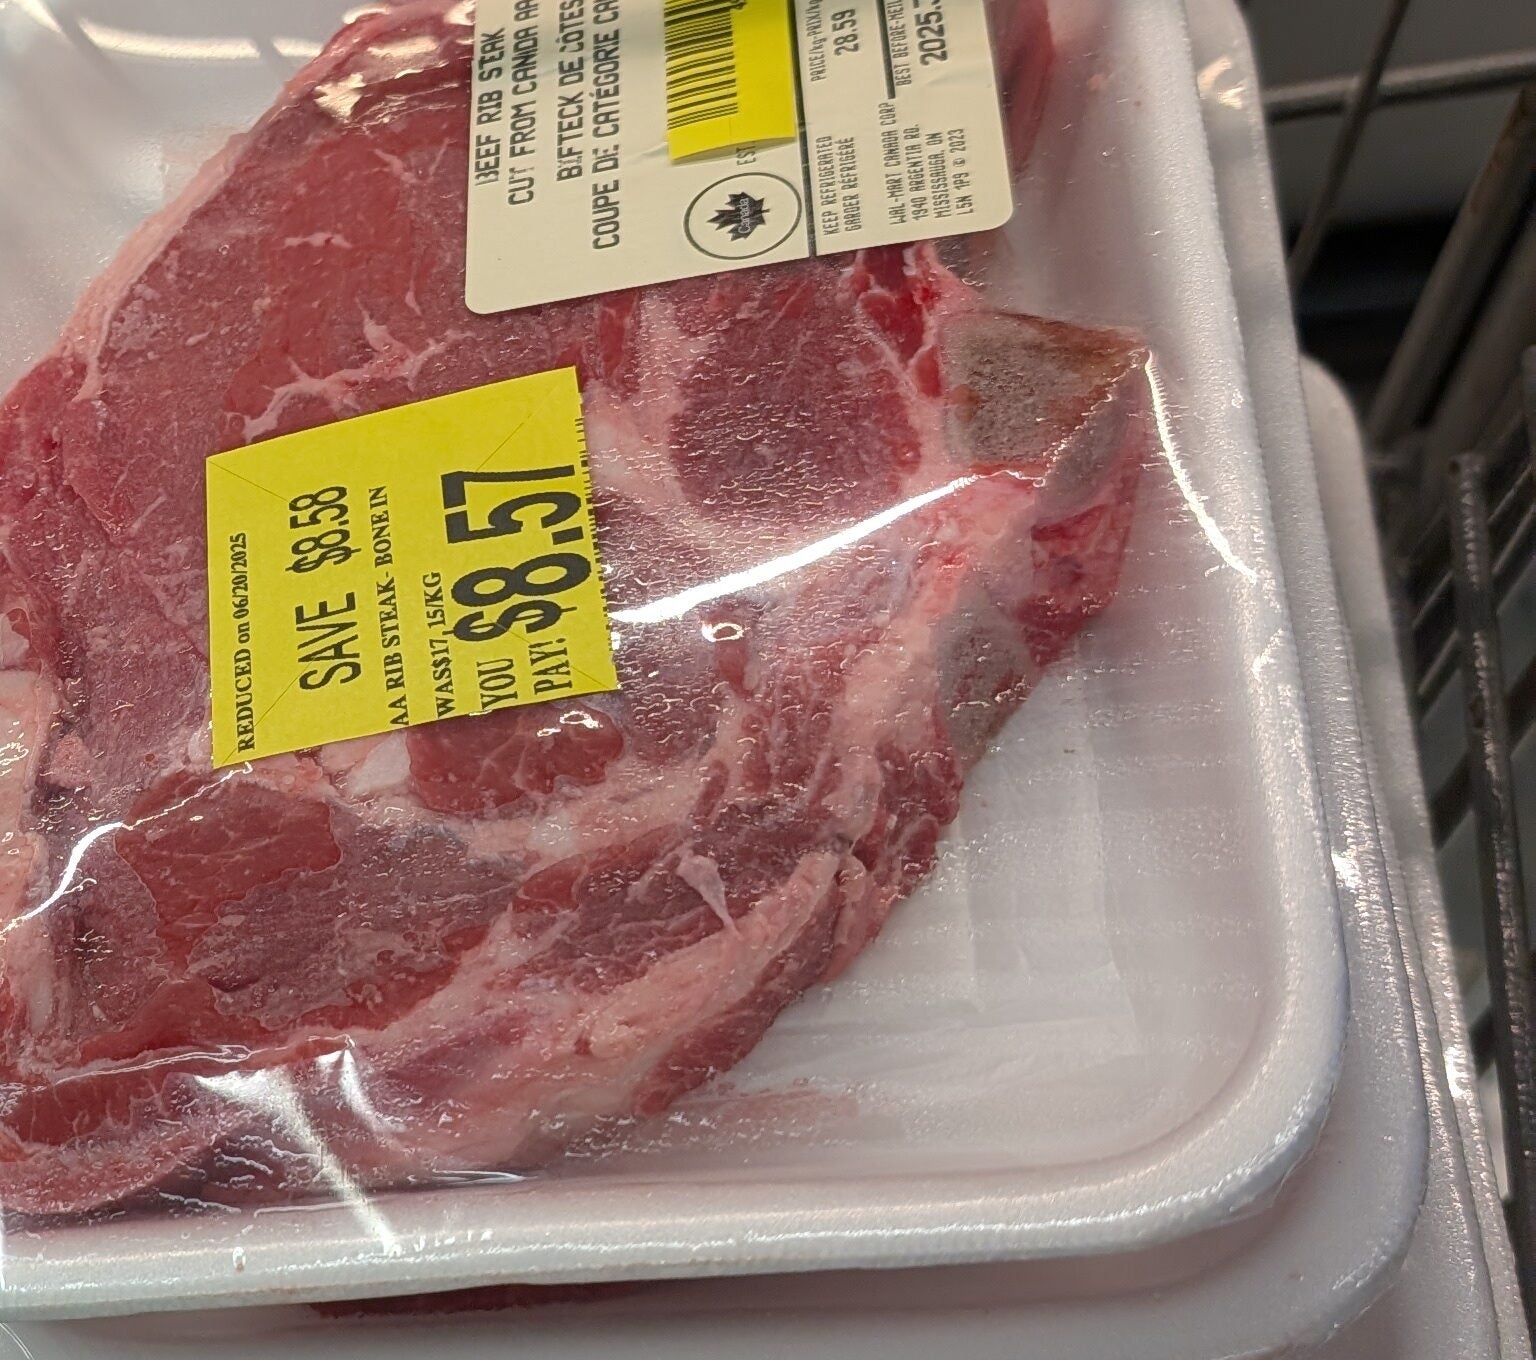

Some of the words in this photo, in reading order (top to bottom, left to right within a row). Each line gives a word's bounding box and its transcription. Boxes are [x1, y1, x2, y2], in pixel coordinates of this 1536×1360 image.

[831, 8, 860, 56] 28.59
[477, 27, 505, 82] STEAK
[558, 56, 585, 87] DE
[893, 63, 913, 87] BEST
[589, 28, 621, 138] CATÉGORIE
[476, 89, 503, 126] RIB
[878, 102, 897, 126] CORP
[509, 99, 537, 158] FROM
[556, 91, 584, 182] BIFTECK
[881, 129, 901, 168] CANADA
[903, 124, 920, 140] RD.
[925, 132, 944, 146] ON
[946, 128, 967, 154] 2023
[474, 134, 501, 186] BEEF
[591, 144, 620, 174] DE
[815, 135, 837, 207] REFRIGERATED
[834, 136, 859, 191] RÉFRIGÉRÉ
[904, 143, 926, 193] ARGENTIA
[508, 167, 535, 206] CUT
[884, 172, 907, 225] WAL-MART
[952, 172, 971, 191] 1P9
[591, 179, 620, 250] COUPE
[735, 195, 753, 236] Canada
[821, 210, 840, 236] KEEP
[842, 193, 863, 232] GARDER
[910, 196, 929, 221] 1940
[954, 194, 974, 216] L5N
[368, 485, 388, 510] IN
[284, 486, 362, 574] $8.58
[370, 509, 394, 569] BONE
[440, 464, 592, 642] $8.57
[229, 532, 250, 620] 06/20/2025
[237, 621, 251, 644] on
[294, 591, 362, 690] SAVE
[383, 652, 406, 691] RIB
[476, 658, 519, 710] YOU
[527, 637, 573, 696] PAY!
[233, 648, 255, 754] REDUCED
[387, 694, 410, 726] AA
